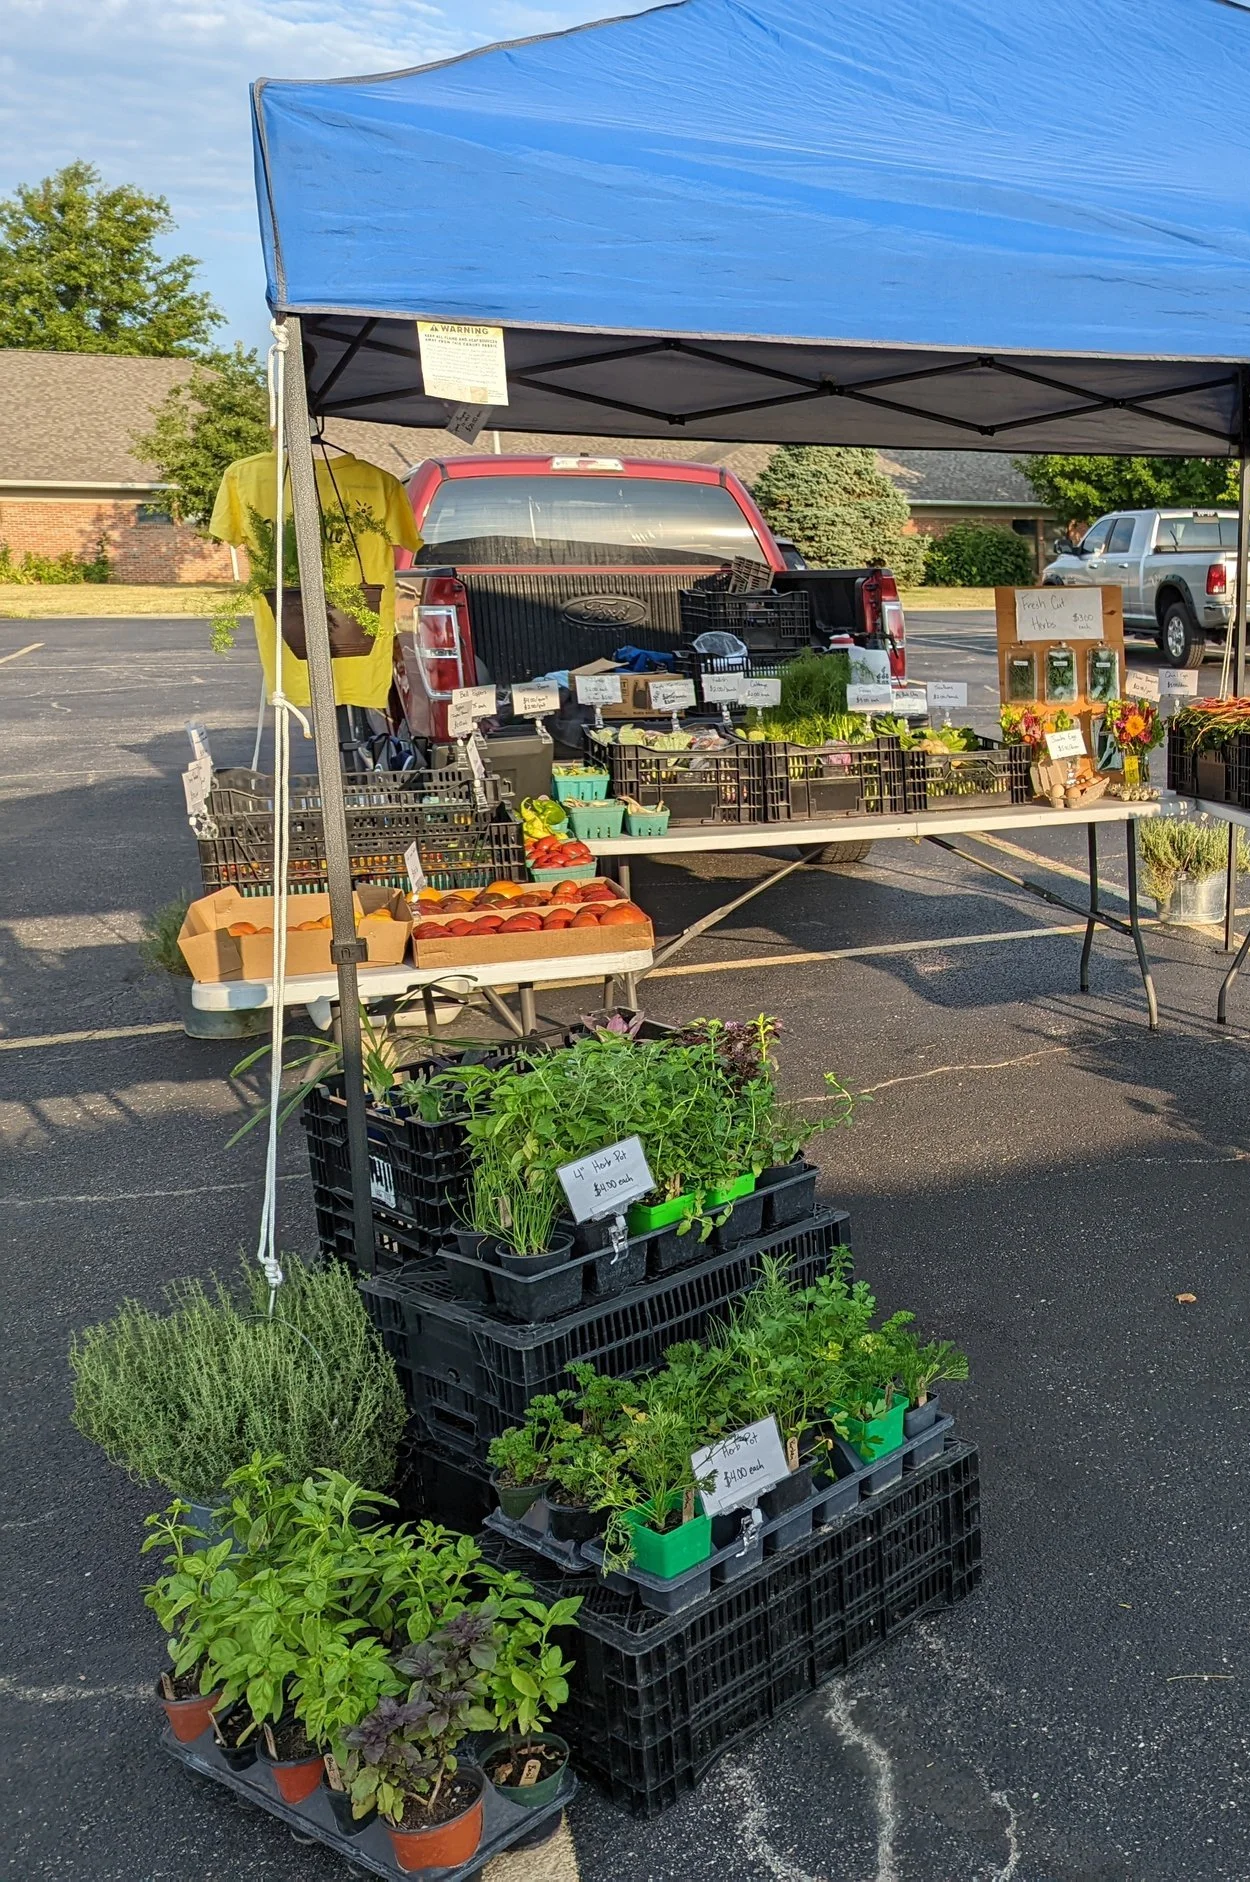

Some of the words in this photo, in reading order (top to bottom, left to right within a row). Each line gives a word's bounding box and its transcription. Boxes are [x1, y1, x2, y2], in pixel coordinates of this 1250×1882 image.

[441, 324, 488, 334] WARNING
[1021, 593, 1046, 611] Fresh
[1050, 594, 1065, 610] Cut
[1031, 616, 1056, 631] Herbs
[591, 1156, 612, 1173] Herb
[612, 1149, 627, 1163] Pot
[593, 1179, 617, 1197] $4.00
[618, 1173, 634, 1187] each
[721, 1441, 740, 1459] Herb
[743, 1431, 758, 1446] Pot
[723, 1466, 748, 1488] $4.00
[749, 1458, 765, 1475] each
